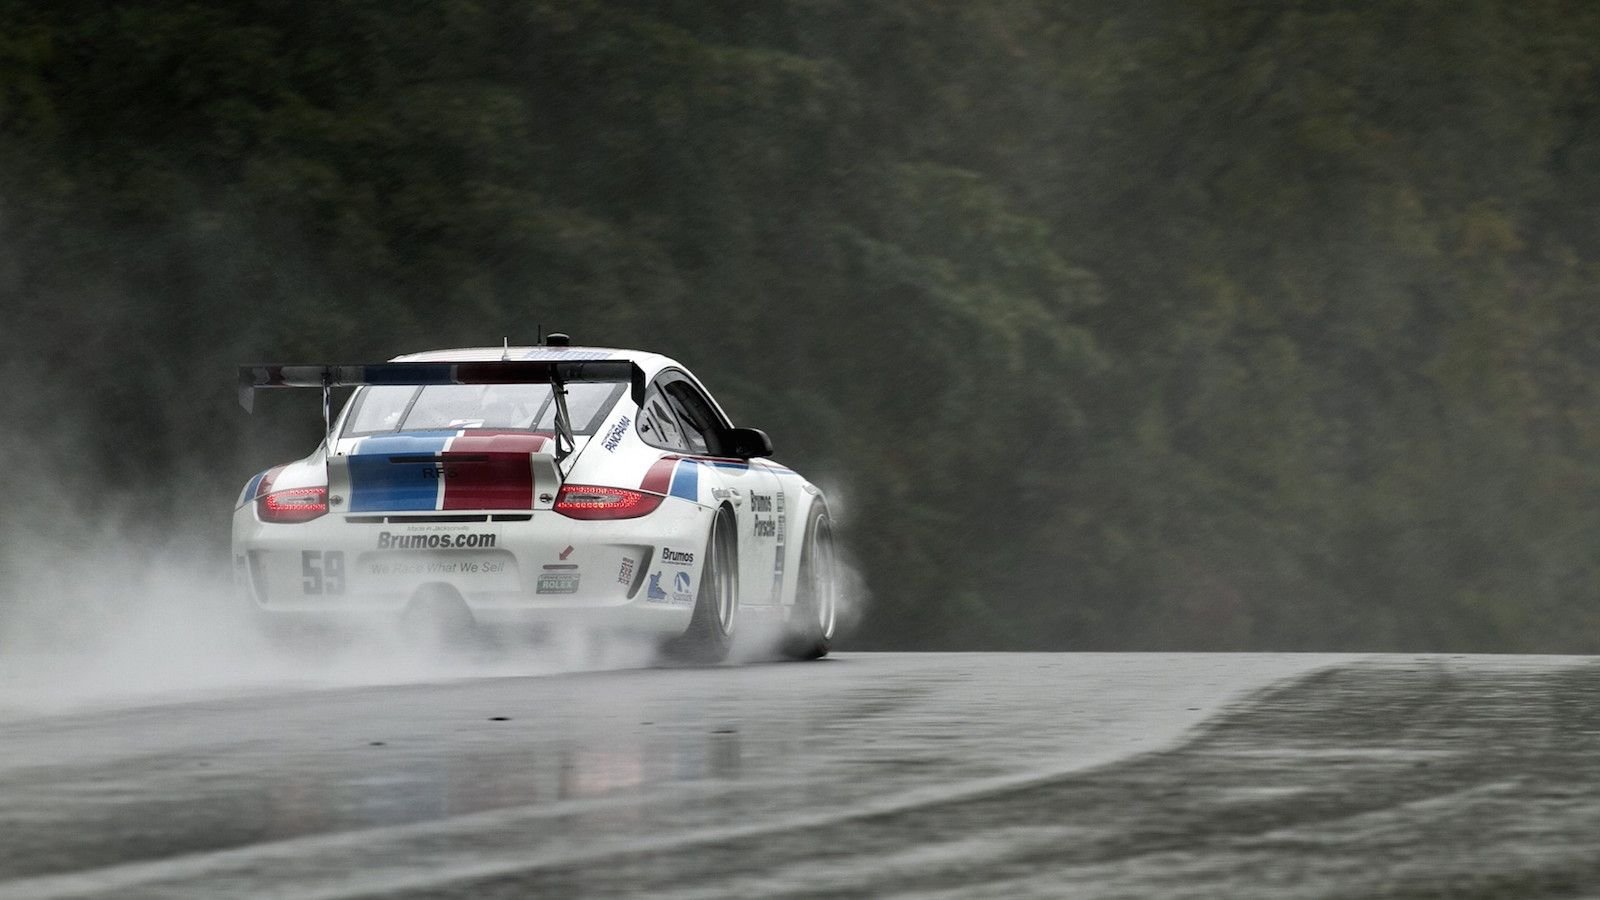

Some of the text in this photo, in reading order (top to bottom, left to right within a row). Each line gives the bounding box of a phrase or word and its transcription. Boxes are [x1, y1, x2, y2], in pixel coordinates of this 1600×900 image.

[605, 415, 631, 453] PANORAMA
[750, 489, 772, 512] Brumos
[753, 513, 776, 537] Porsche
[378, 531, 496, 549] Brumos.com
[661, 547, 694, 563] Brumos
[301, 549, 346, 595] 59
[427, 559, 456, 573] What
[459, 559, 479, 573] We
[481, 559, 505, 573] Sell
[542, 580, 573, 589] ROLEX
